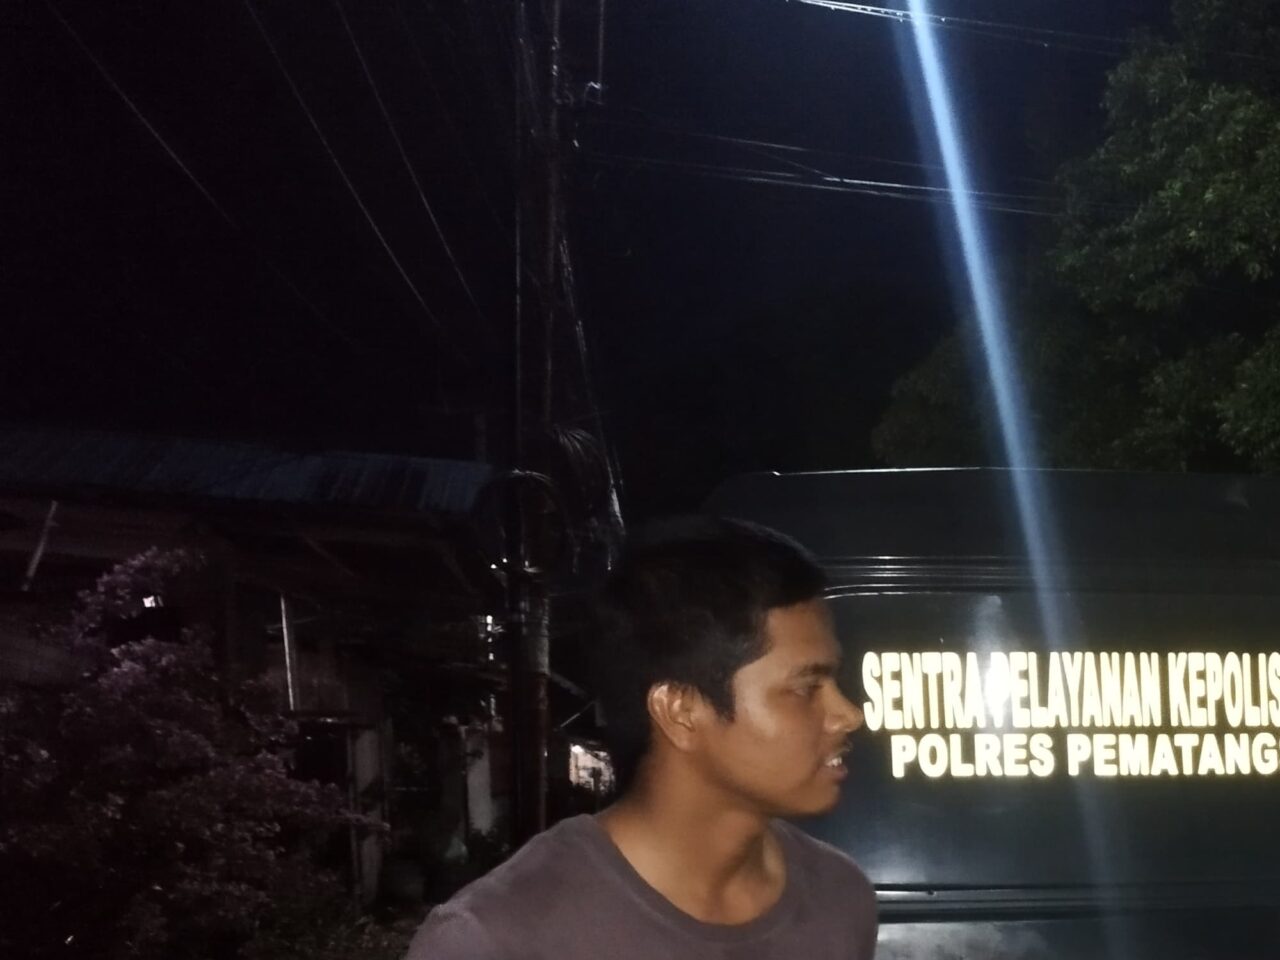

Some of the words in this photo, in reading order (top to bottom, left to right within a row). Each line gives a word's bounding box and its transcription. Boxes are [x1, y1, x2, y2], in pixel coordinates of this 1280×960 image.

[862, 651, 988, 731] SENTRA
[989, 651, 1161, 728] PELAYANAN
[890, 733, 1055, 778] POLRES
